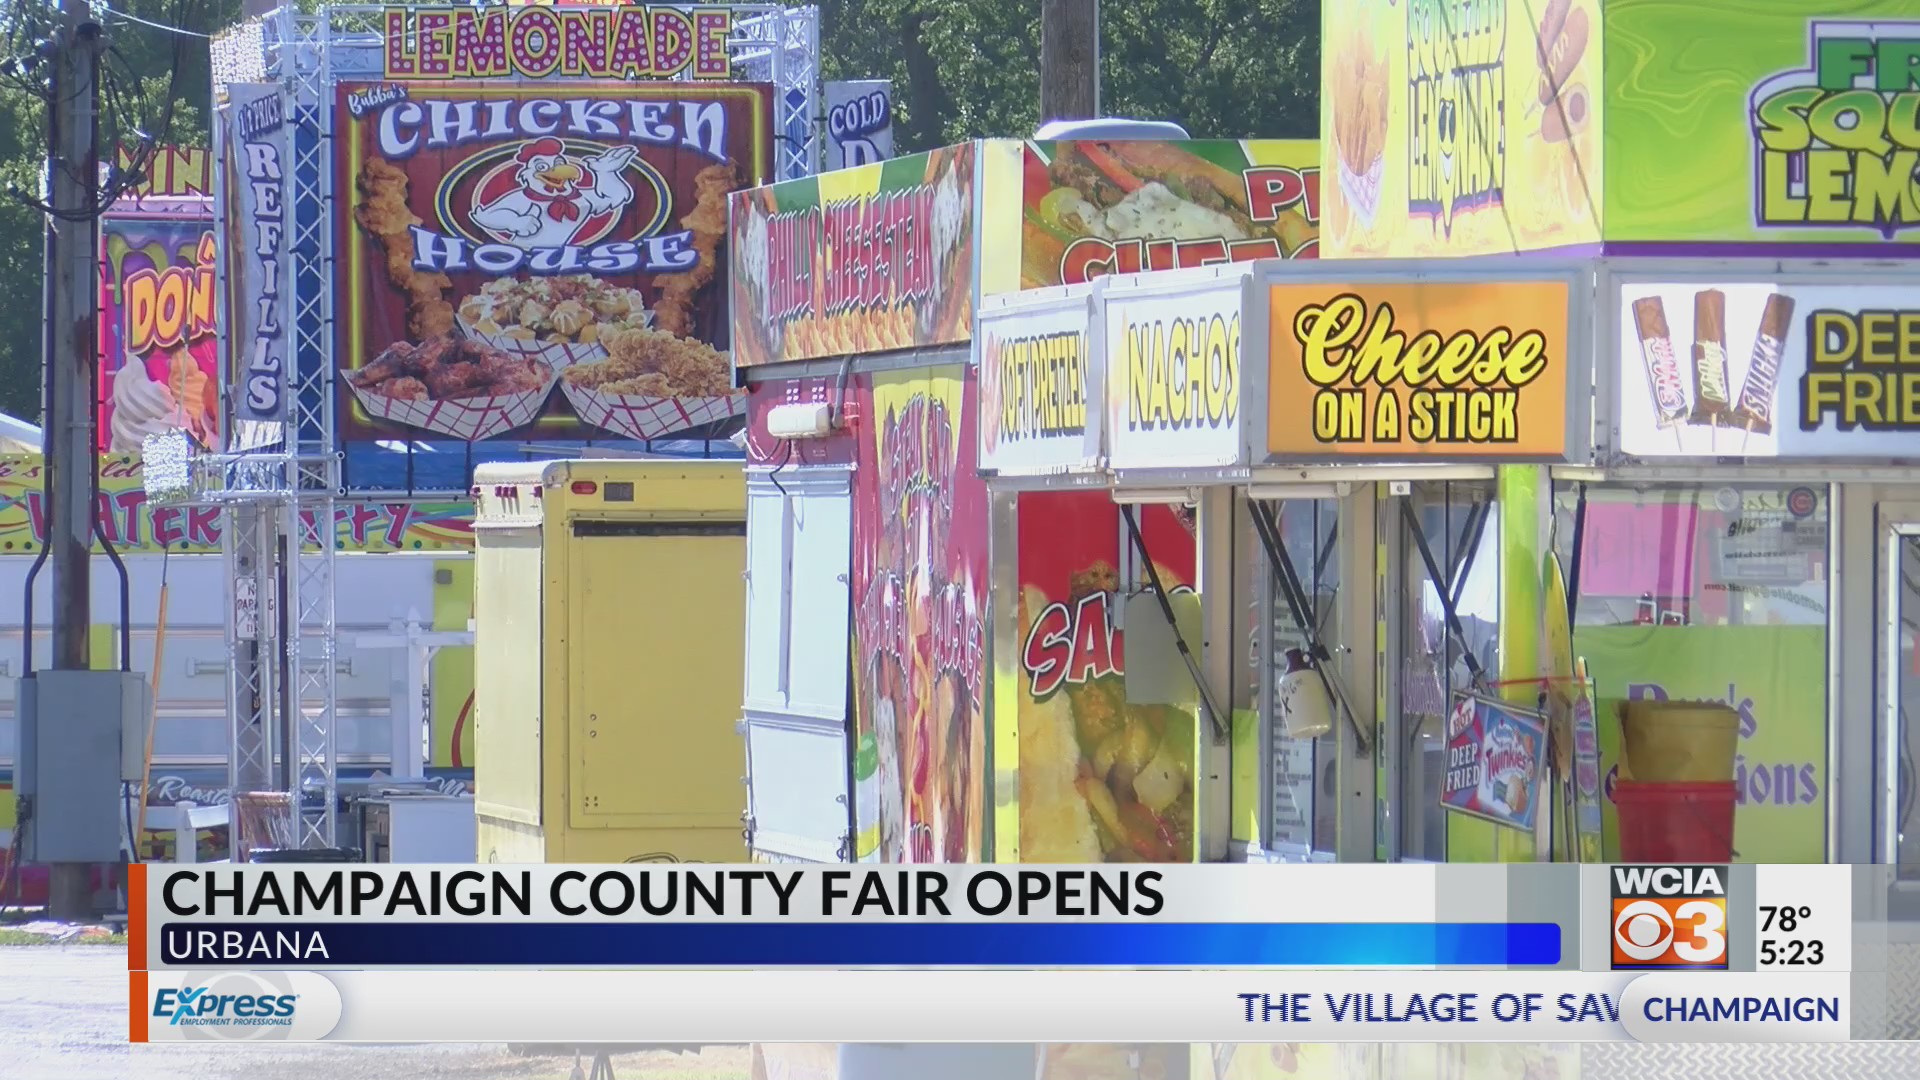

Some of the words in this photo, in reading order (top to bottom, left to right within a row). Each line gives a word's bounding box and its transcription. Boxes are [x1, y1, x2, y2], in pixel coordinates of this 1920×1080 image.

[386, 7, 731, 79] LEMONADE
[1818, 38, 1920, 91] FR
[349, 84, 407, 115] Bubba's
[376, 99, 730, 163] CHICKEN
[831, 92, 888, 136] COLD
[1757, 86, 1920, 157] SQU
[1761, 148, 1920, 223] LEM
[245, 142, 286, 413] REFILLS
[407, 225, 698, 273] HOUSE
[767, 204, 822, 322] PHILLY
[125, 264, 216, 351] DON
[1294, 292, 1549, 390] Cheese
[1001, 335, 1028, 443] SOFT
[1128, 312, 1241, 432] NACHOS
[1312, 387, 1364, 443] ON
[1373, 387, 1401, 443] A
[1408, 387, 1518, 443] STICK
[1453, 708, 1473, 734] HOT
[1446, 764, 1480, 793] FRIED
[1451, 742, 1479, 768] DEEP
